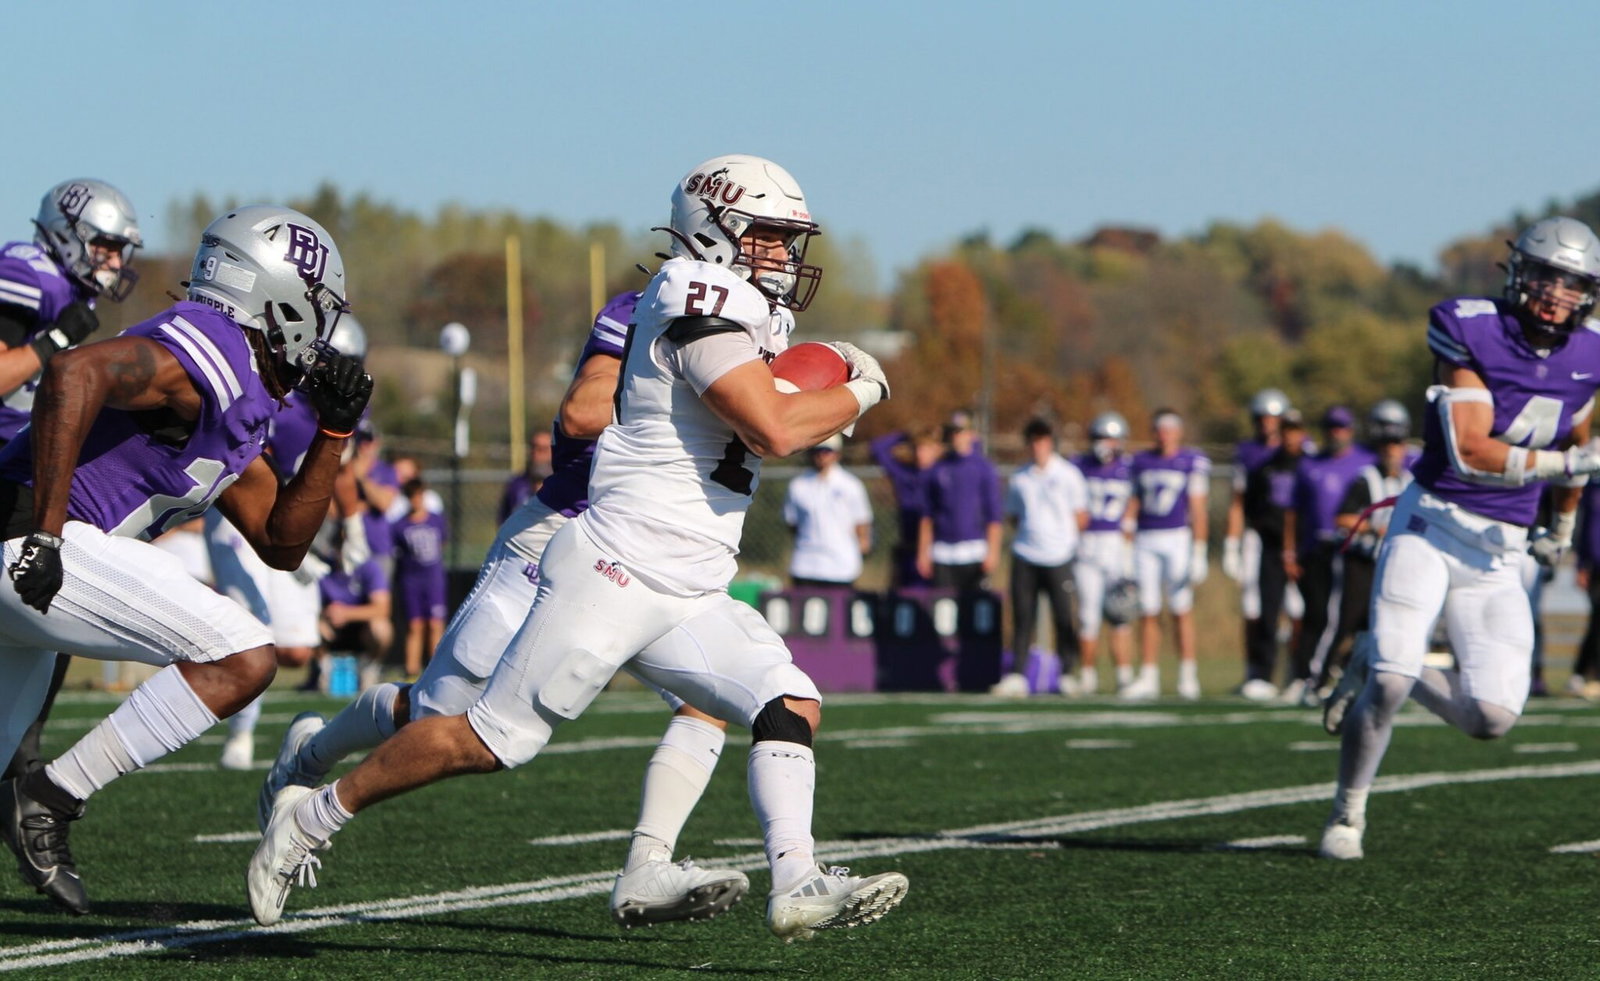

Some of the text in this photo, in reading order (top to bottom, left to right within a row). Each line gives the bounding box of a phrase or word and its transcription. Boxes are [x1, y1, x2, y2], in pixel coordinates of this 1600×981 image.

[684, 172, 746, 206] SMU
[203, 255, 217, 281] 9
[283, 222, 330, 283] BU
[684, 281, 729, 317] 27
[594, 558, 631, 588] SMU
